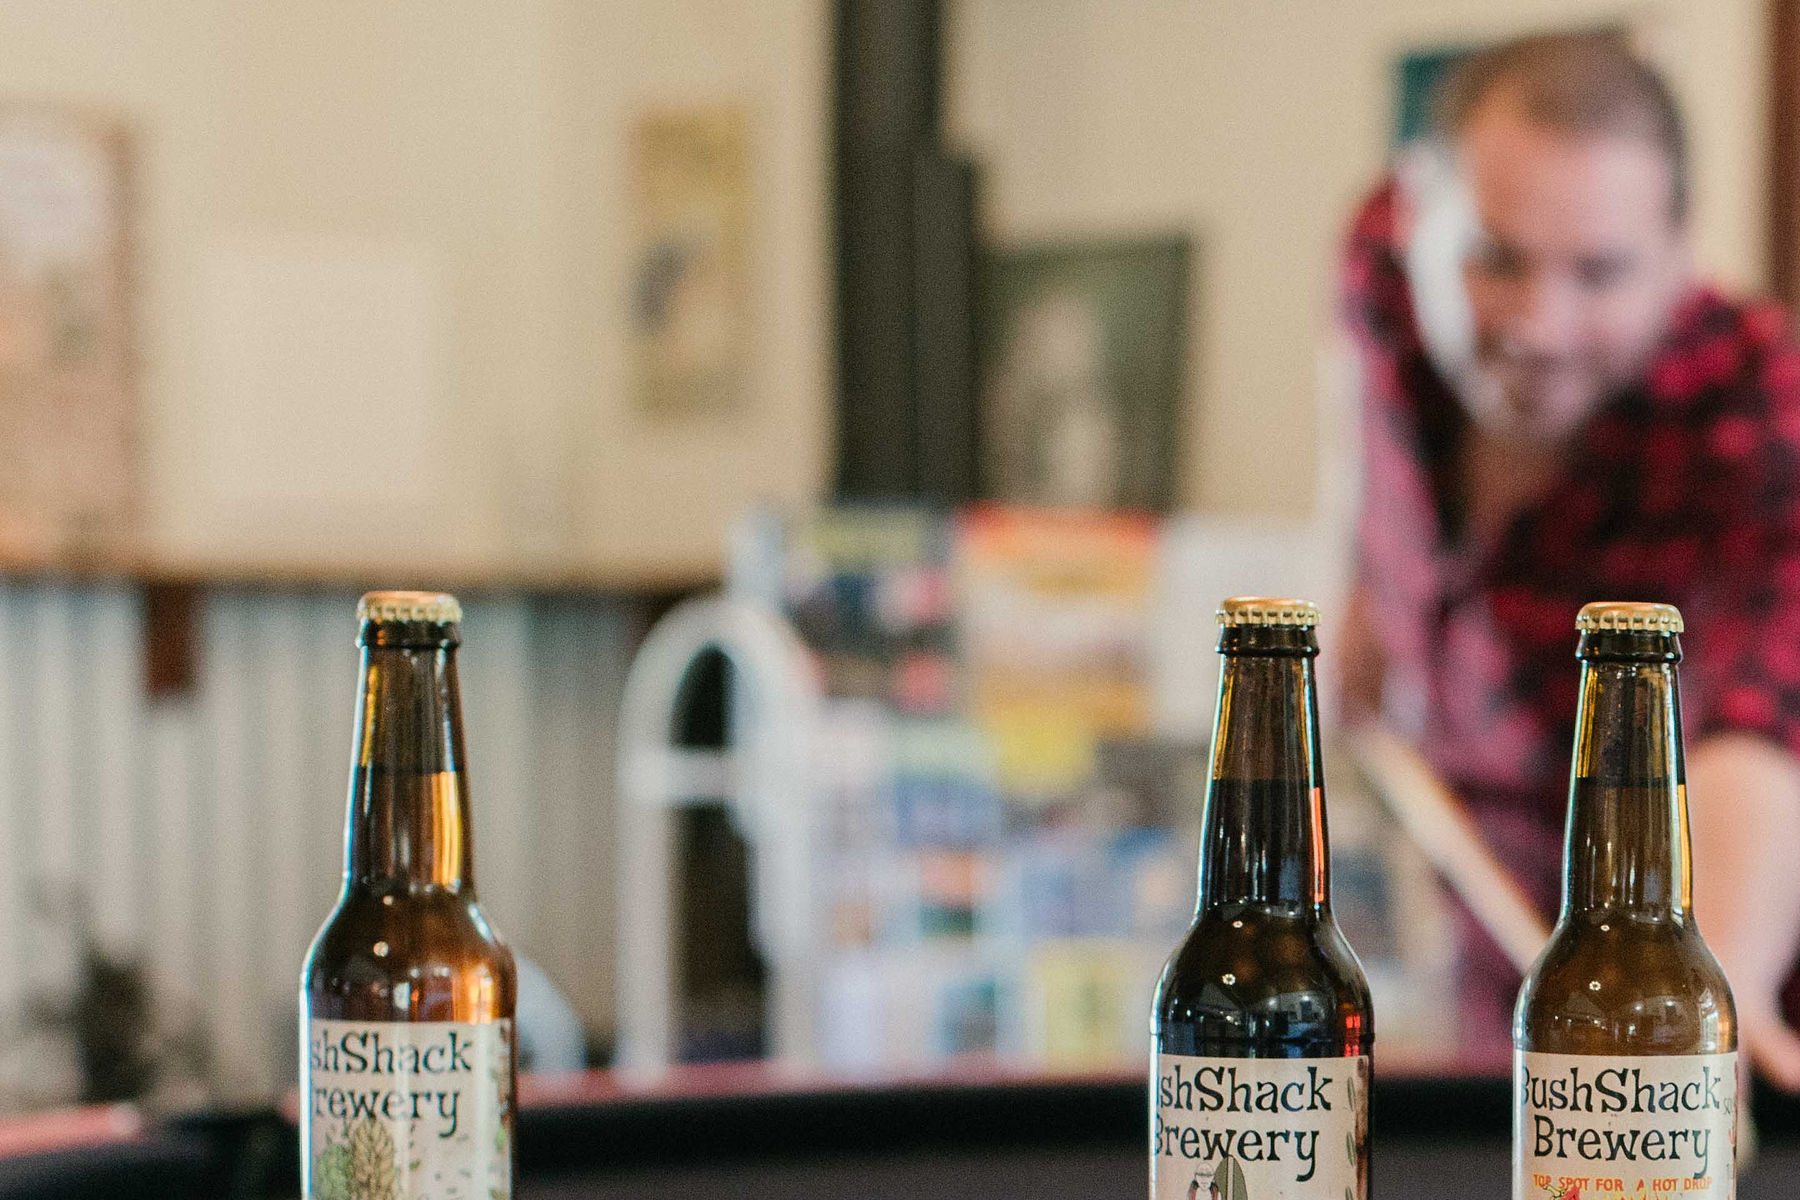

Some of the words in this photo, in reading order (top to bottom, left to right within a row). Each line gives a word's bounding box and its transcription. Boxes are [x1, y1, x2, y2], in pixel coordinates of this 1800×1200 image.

[1158, 1064, 1333, 1114] shShack
[312, 1090, 459, 1138] rewery
[1534, 1114, 1711, 1180] Brewery
[1532, 1173, 1552, 1188] TOP
[1558, 1176, 1590, 1192] SPOT
[1595, 1178, 1624, 1193] FOR
[1636, 1178, 1646, 1192] A
[1652, 1178, 1679, 1192] HOT
[1683, 1176, 1712, 1191] DROP
